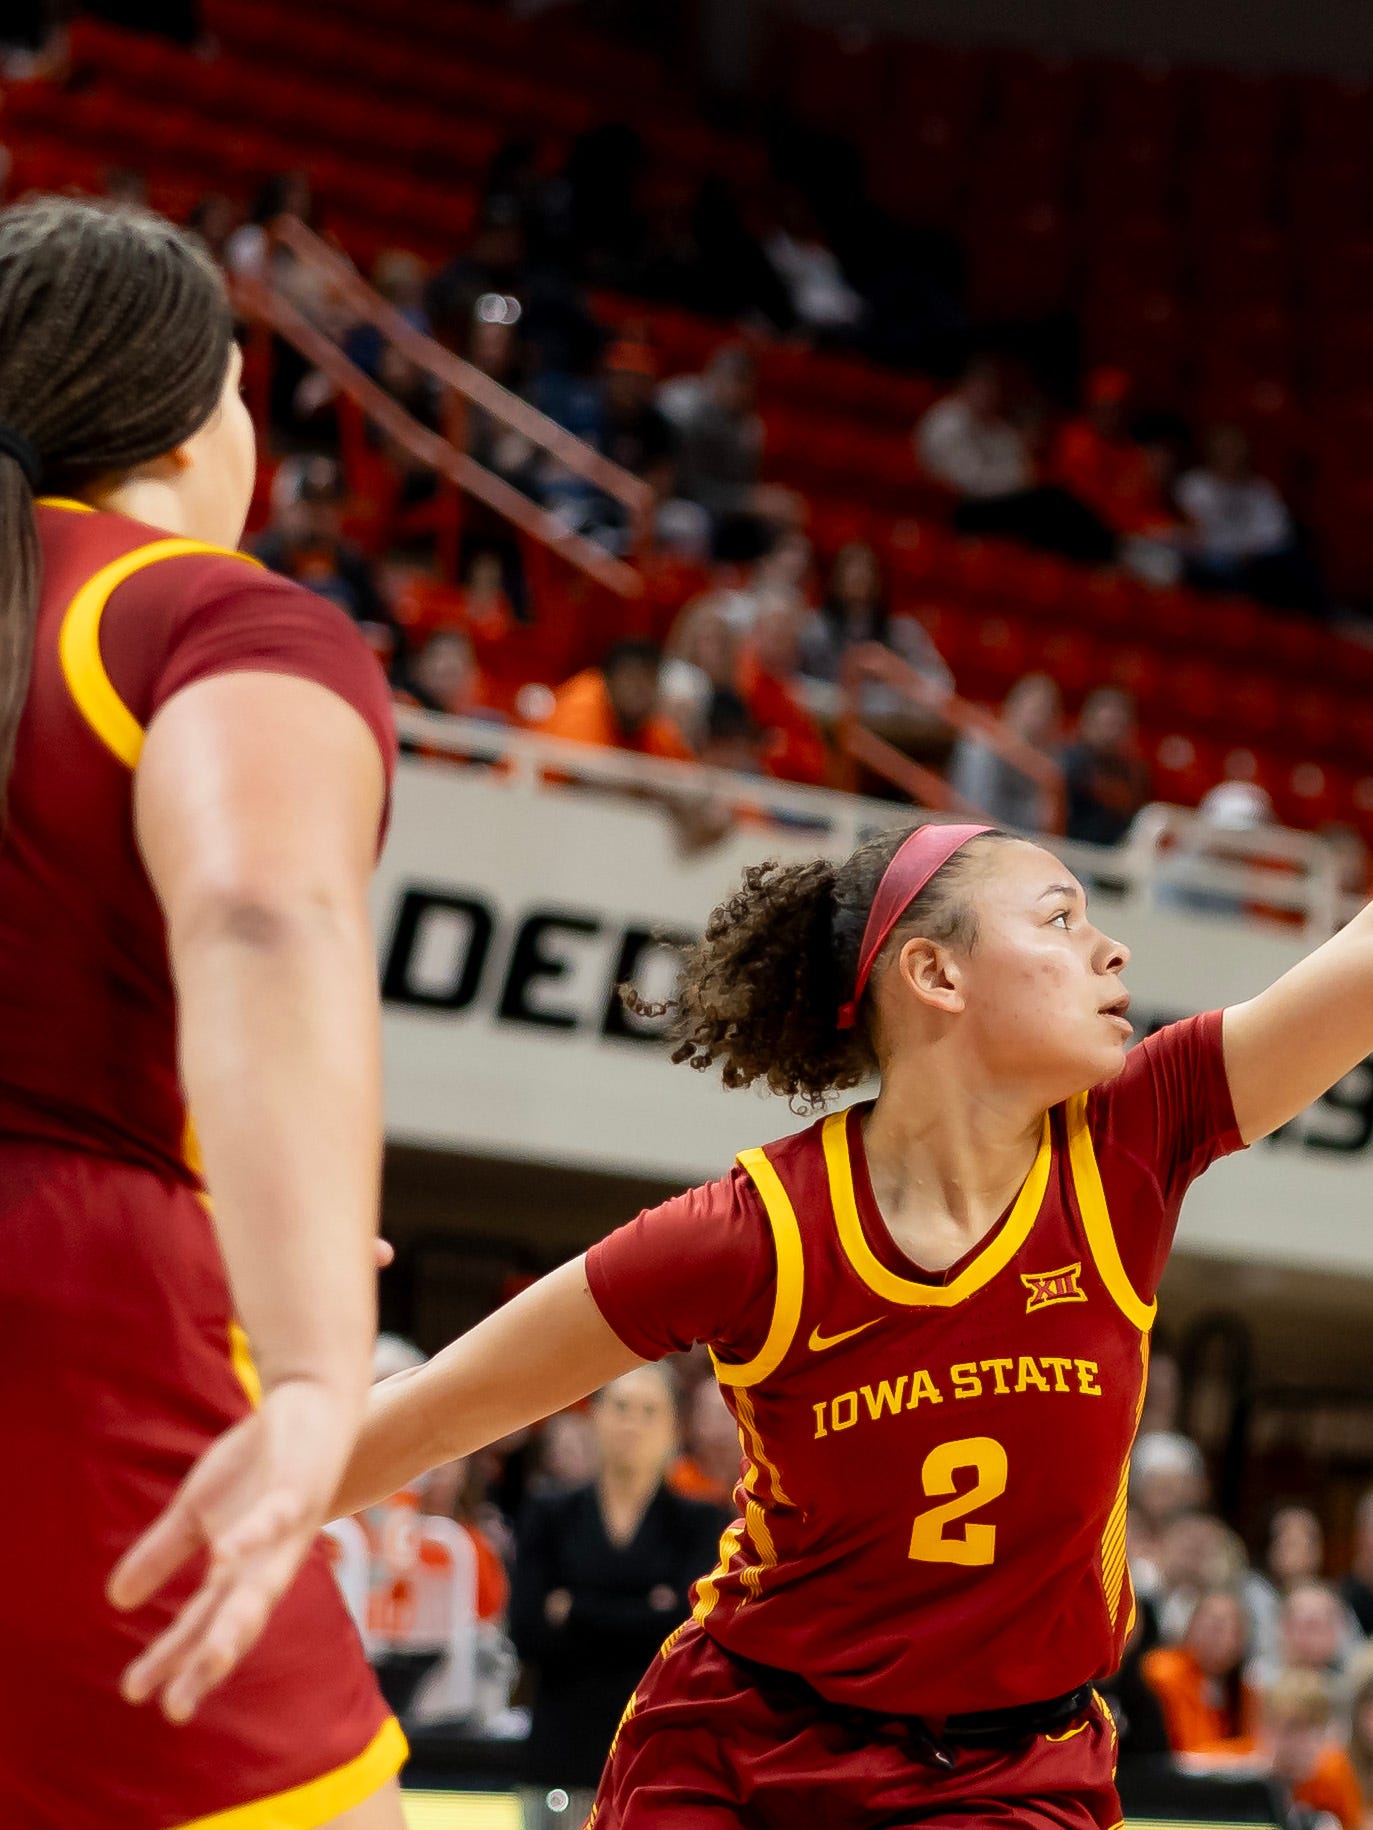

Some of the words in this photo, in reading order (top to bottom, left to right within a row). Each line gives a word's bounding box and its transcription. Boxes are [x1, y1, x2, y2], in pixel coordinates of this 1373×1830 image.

[1029, 1270, 1081, 1305] XII
[812, 1370, 943, 1440] IOWA
[950, 1356, 1102, 1400] STATE
[908, 1436, 1008, 1566] 2
